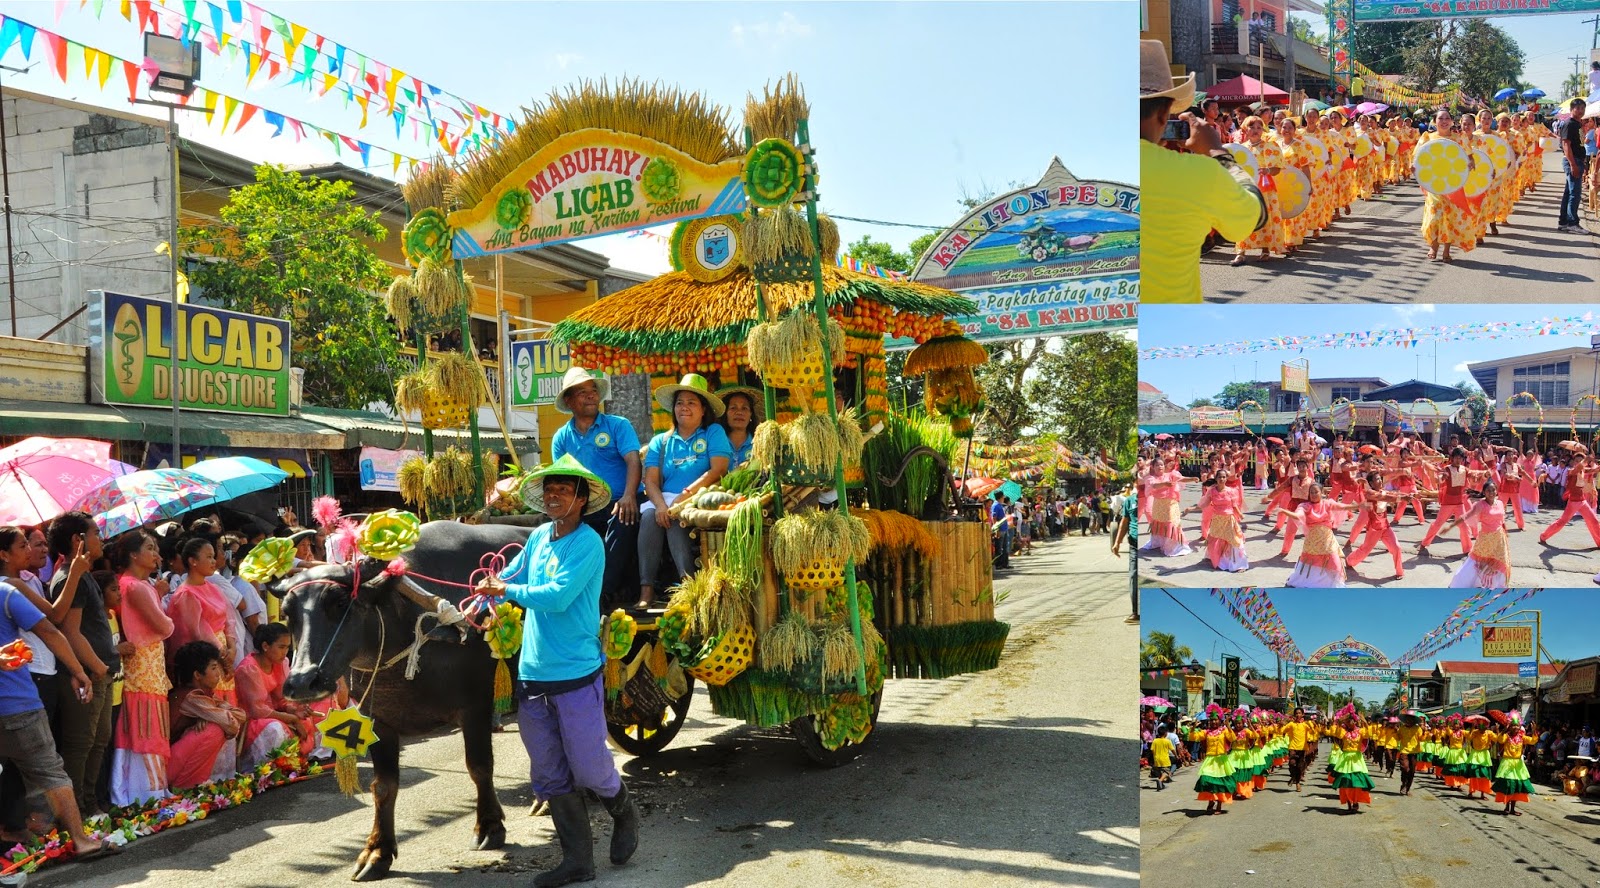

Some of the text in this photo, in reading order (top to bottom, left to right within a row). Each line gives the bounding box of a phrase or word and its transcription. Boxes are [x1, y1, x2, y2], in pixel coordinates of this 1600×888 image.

[1393, 5, 1420, 15] Tema:
[525, 147, 651, 204] MABUHAY!
[554, 179, 634, 219] LICAB
[485, 193, 703, 250] Ang Bayan ng Kariton Festival
[932, 190, 1051, 271] KARITON
[1032, 264, 1084, 278] Bagong
[986, 286, 1087, 311] Pagkakatatag
[1093, 286, 1111, 302] ng
[1038, 302, 1138, 327] KABUKI
[146, 304, 283, 371] LICAB
[533, 344, 573, 374] LIC
[153, 364, 277, 409] DRUGSTORE
[325, 718, 365, 749] 4
